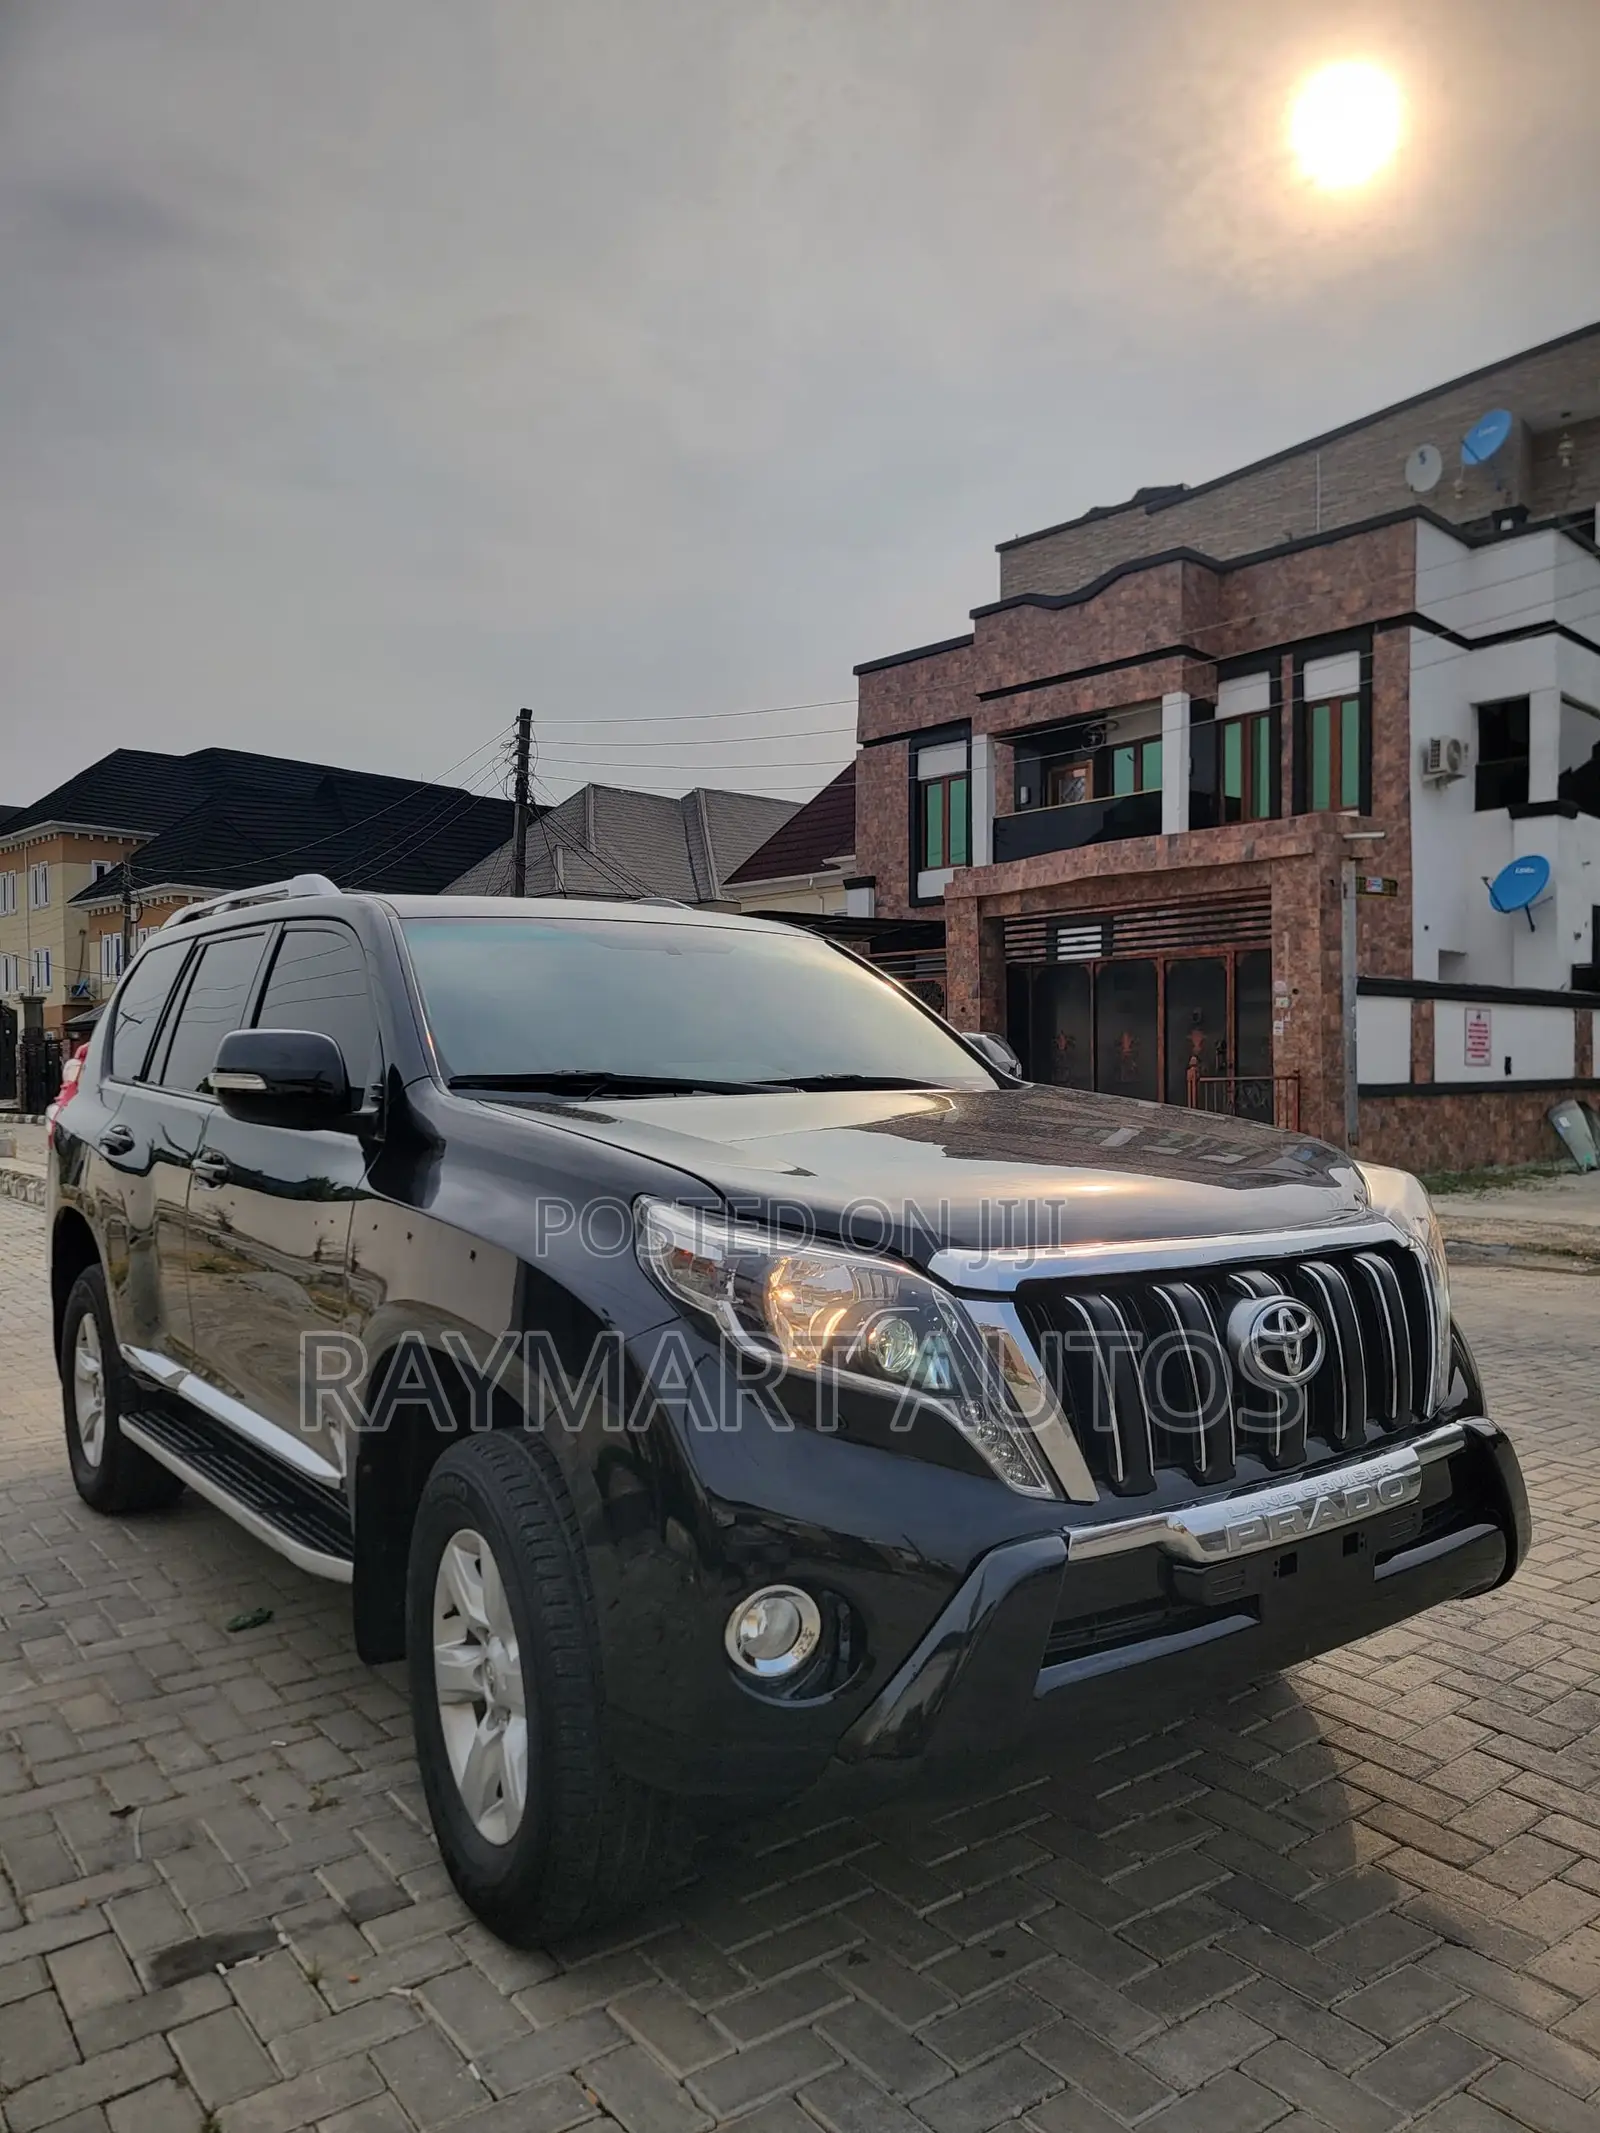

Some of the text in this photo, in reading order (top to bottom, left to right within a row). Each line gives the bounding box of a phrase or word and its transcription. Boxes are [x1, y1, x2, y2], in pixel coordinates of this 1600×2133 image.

[1224, 1472, 1406, 1553] PRADO
[1228, 1462, 1395, 1519] LAND CRUISER
